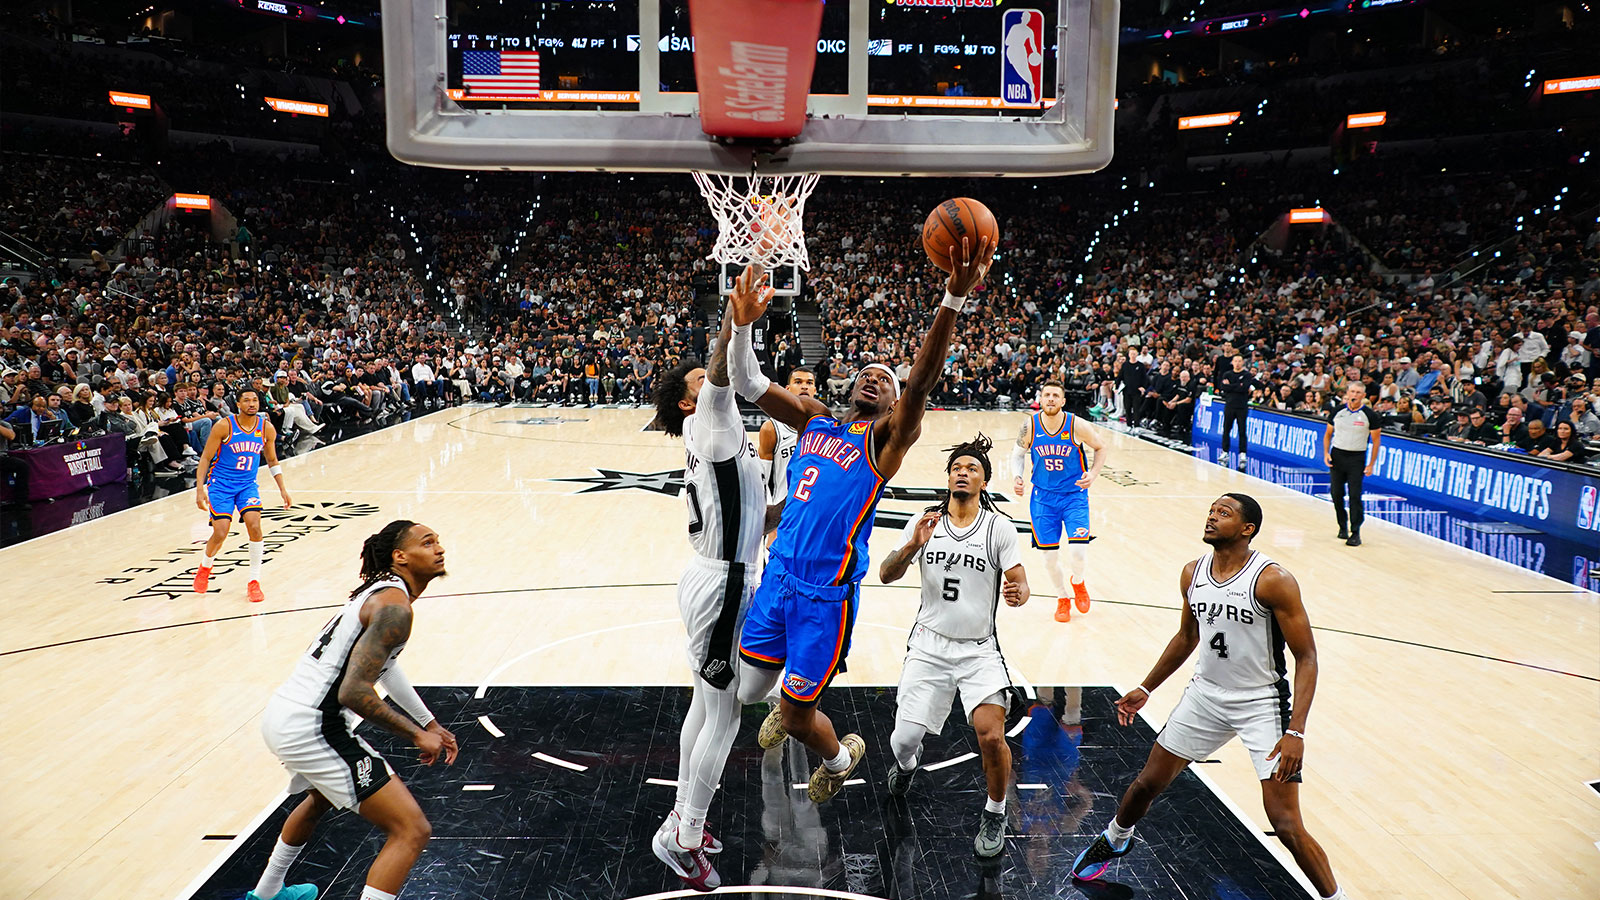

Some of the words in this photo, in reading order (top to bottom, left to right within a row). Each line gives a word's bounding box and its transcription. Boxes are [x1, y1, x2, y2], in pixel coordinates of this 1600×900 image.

[504, 37, 520, 47] TO
[538, 37, 564, 48] FG%
[590, 38, 605, 48] PF
[816, 39, 846, 53] OKC
[898, 43, 913, 53] PF
[933, 44, 960, 54] FG%
[980, 45, 996, 55] TO
[1007, 83, 1028, 100] NBA
[800, 431, 862, 471] THUNDER
[1034, 443, 1073, 458] THUNDER
[1276, 423, 1318, 459] PLAYOFFS
[236, 455, 254, 471] 21
[1044, 458, 1064, 472] 55
[793, 465, 820, 502] 2
[1386, 447, 1403, 482] TO
[1402, 450, 1447, 493] WATCH
[1446, 460, 1476, 501] THE
[1473, 466, 1553, 520] PLAYOFFS
[926, 551, 986, 573] SPURS
[942, 577, 961, 602] 5
[1190, 602, 1254, 626] SPURS
[1209, 631, 1229, 660] 4
